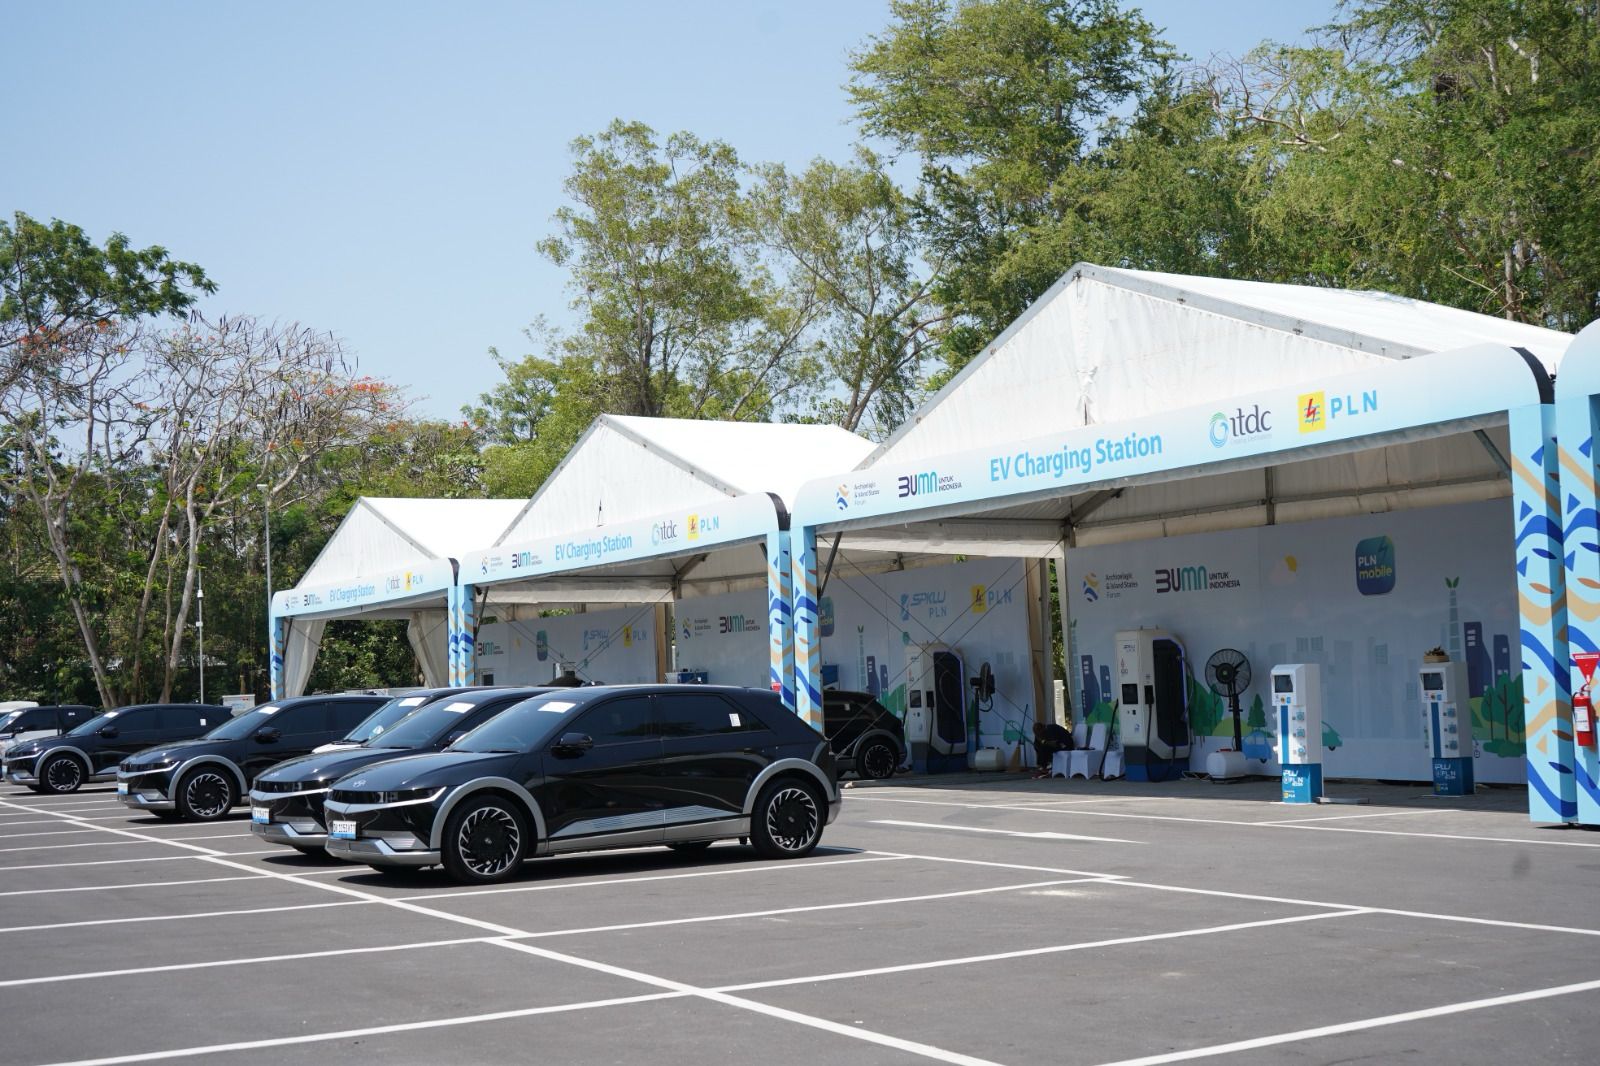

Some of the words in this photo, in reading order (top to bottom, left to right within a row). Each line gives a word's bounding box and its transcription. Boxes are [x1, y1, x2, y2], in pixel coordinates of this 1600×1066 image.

[1330, 390, 1378, 419] PLN
[1229, 404, 1272, 437] itdc
[990, 456, 1011, 482] EV
[1014, 445, 1092, 478] Charging
[1096, 432, 1162, 465] Station
[898, 471, 938, 498] BUMN
[939, 475, 954, 484] UNTUK
[939, 482, 962, 492] INDONESIA
[660, 520, 678, 540] itdc
[701, 515, 719, 533] PLN
[555, 544, 566, 561] EV
[566, 538, 602, 560] Charging
[603, 533, 632, 553] Station
[1359, 555, 1377, 567] PLN
[1155, 565, 1208, 593] BUMN
[1209, 572, 1229, 581] UNTUK
[1360, 565, 1392, 579] mobile
[1209, 580, 1241, 589] INDONESIA
[987, 590, 1012, 606] PLN
[929, 607, 947, 619] PLN
[632, 630, 647, 642] PLN
